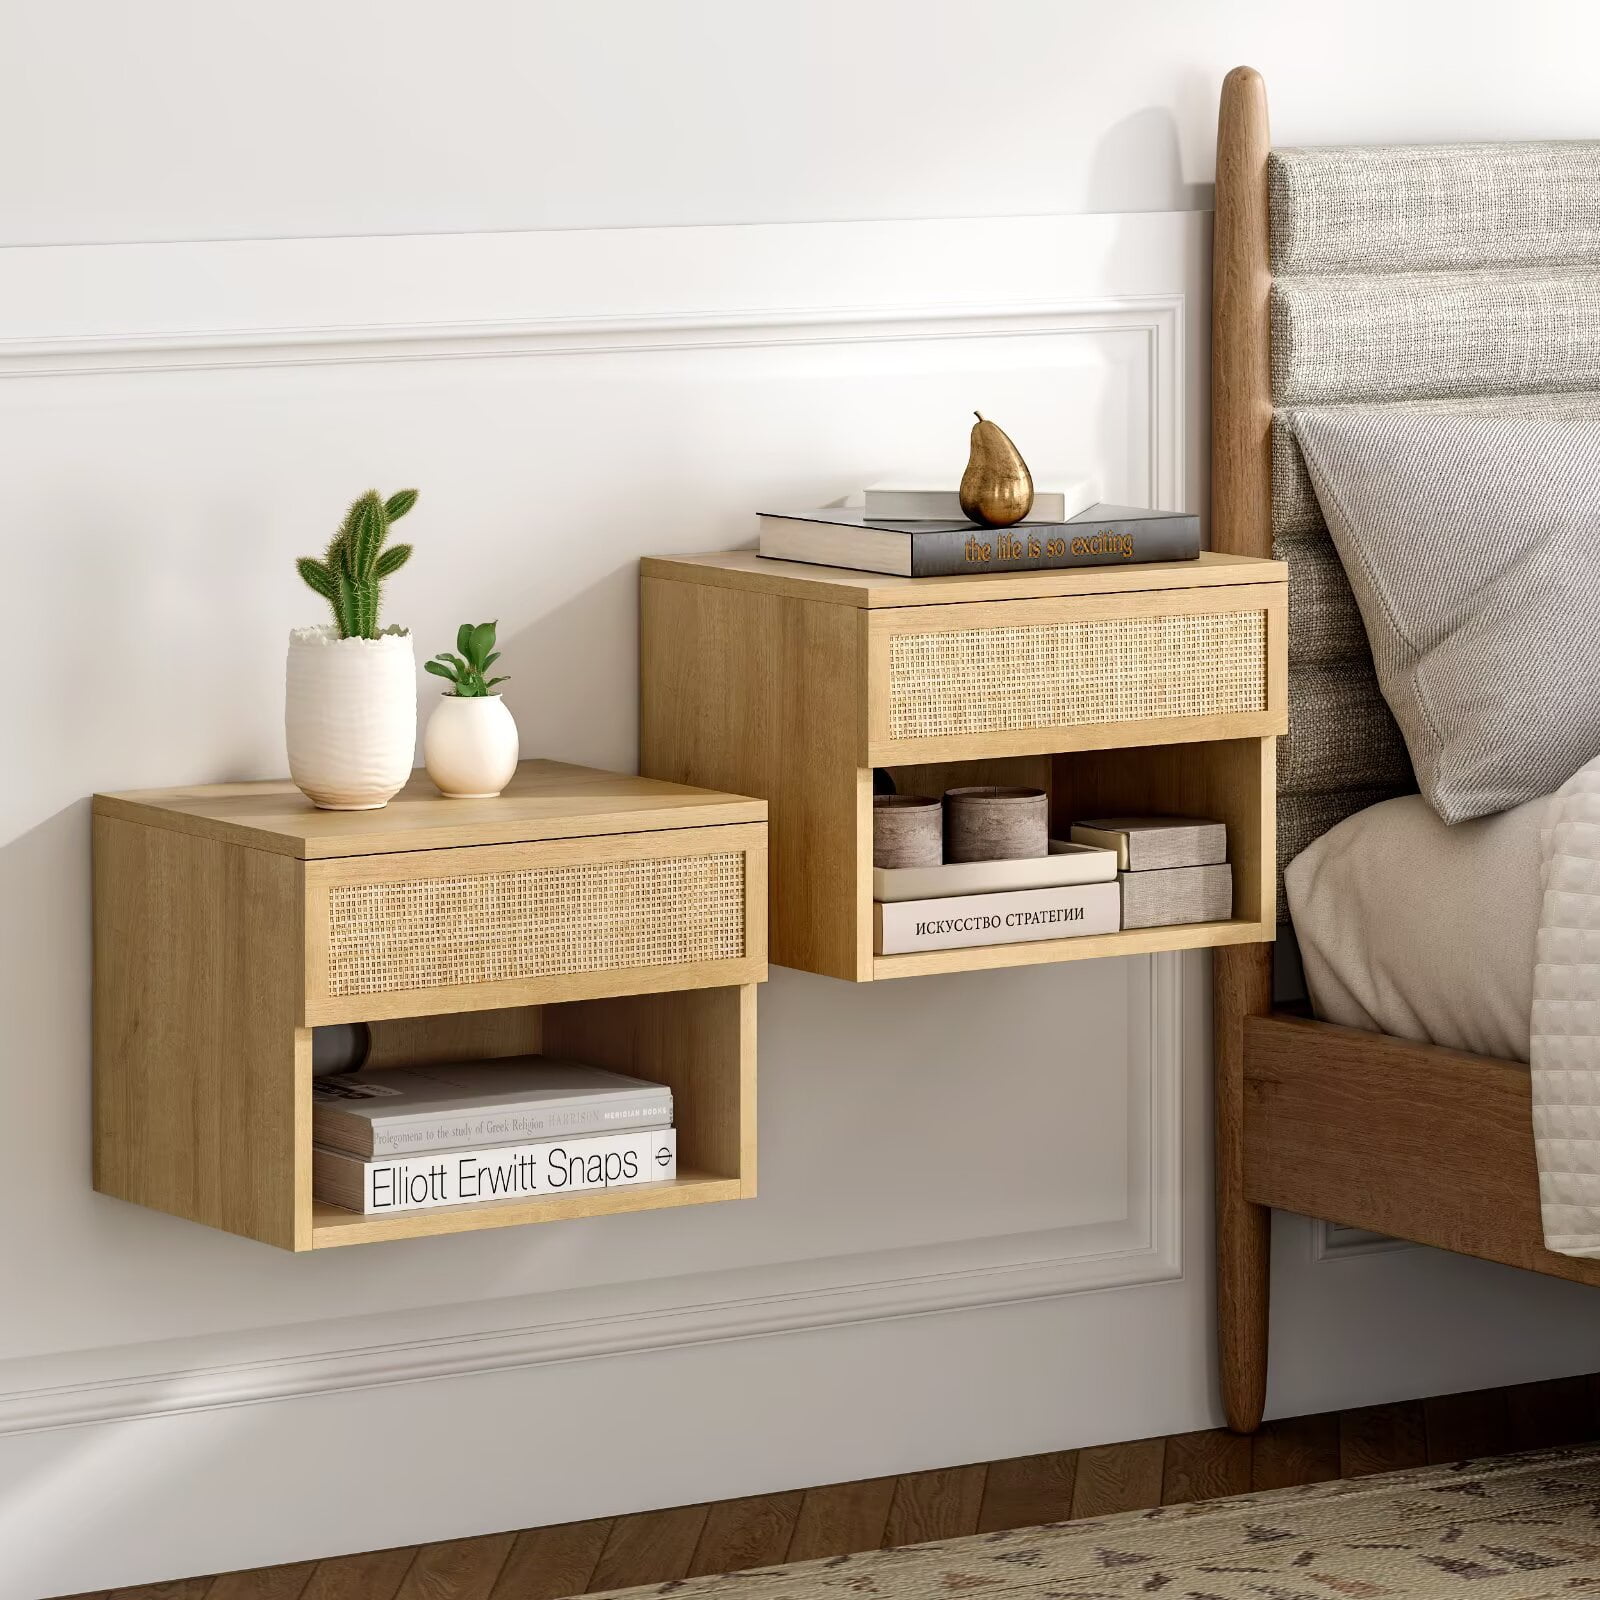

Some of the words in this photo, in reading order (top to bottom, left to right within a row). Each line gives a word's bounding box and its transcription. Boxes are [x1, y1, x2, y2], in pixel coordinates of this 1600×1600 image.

[964, 534, 991, 562] the
[997, 532, 1022, 560] life
[1027, 534, 1041, 558] is
[1046, 538, 1065, 558] so
[1071, 529, 1135, 558] exciting
[915, 915, 1001, 936] ИСКУССТВО
[1005, 907, 1085, 927] СТРАТЕГИИ
[426, 1131, 434, 1140] to
[437, 1126, 449, 1139] the
[452, 1122, 472, 1141] study
[475, 1120, 485, 1134] of
[486, 1119, 509, 1134] Greek
[512, 1115, 545, 1136] Religion
[604, 1109, 640, 1120] MERIDIAN
[642, 1106, 667, 1117] BOOKS
[373, 1164, 447, 1208] Elliott
[459, 1153, 537, 1197] Erwitt
[547, 1147, 638, 1188] Snaps
